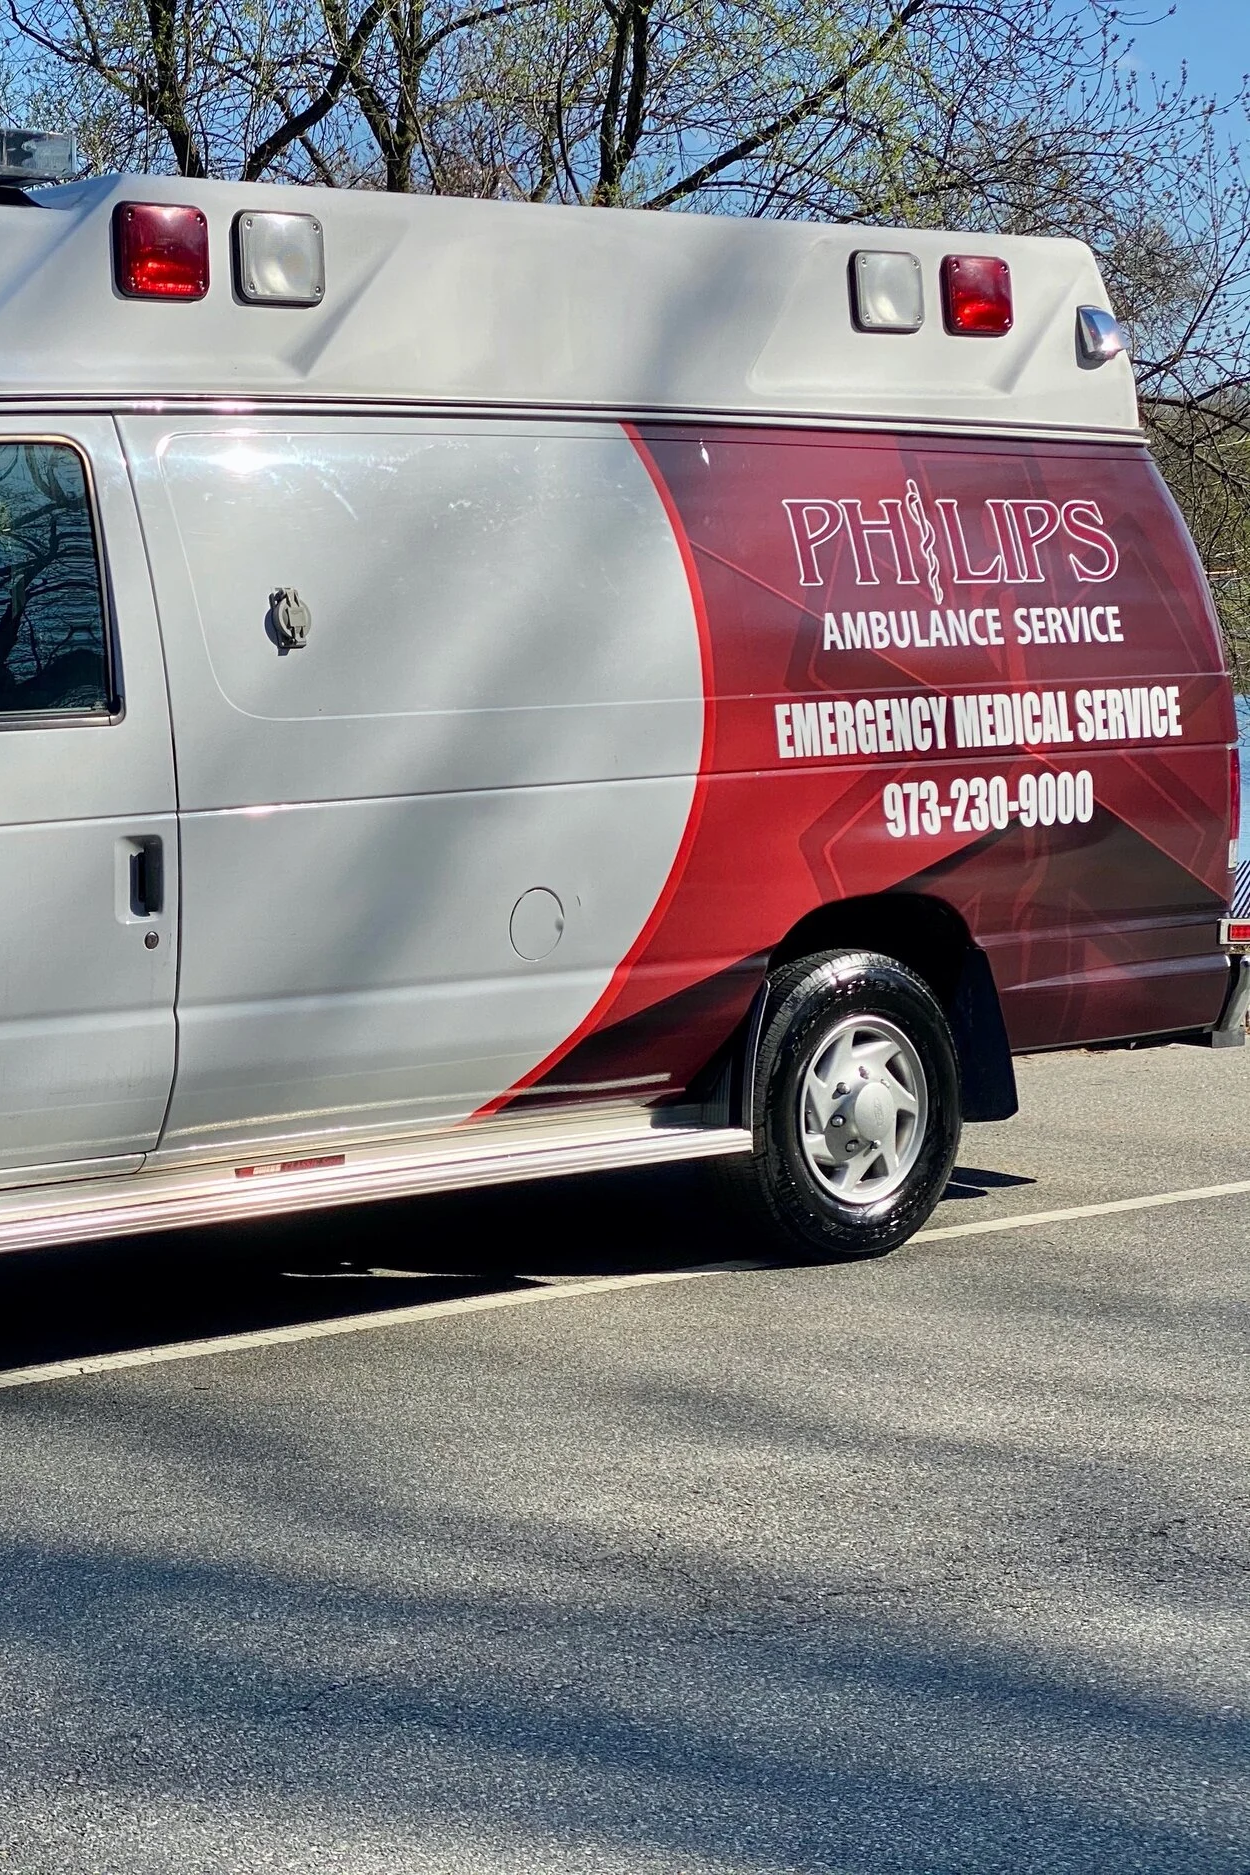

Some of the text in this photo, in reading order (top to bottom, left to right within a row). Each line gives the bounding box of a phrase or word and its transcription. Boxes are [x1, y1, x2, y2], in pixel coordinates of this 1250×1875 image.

[781, 479, 1119, 605] PHILIPS
[822, 605, 1125, 651] AMBULANCE SERVICE
[774, 685, 1183, 760] EMERGENCY MEDICAL SERVICE
[883, 769, 1094, 838] 973-230-9000
